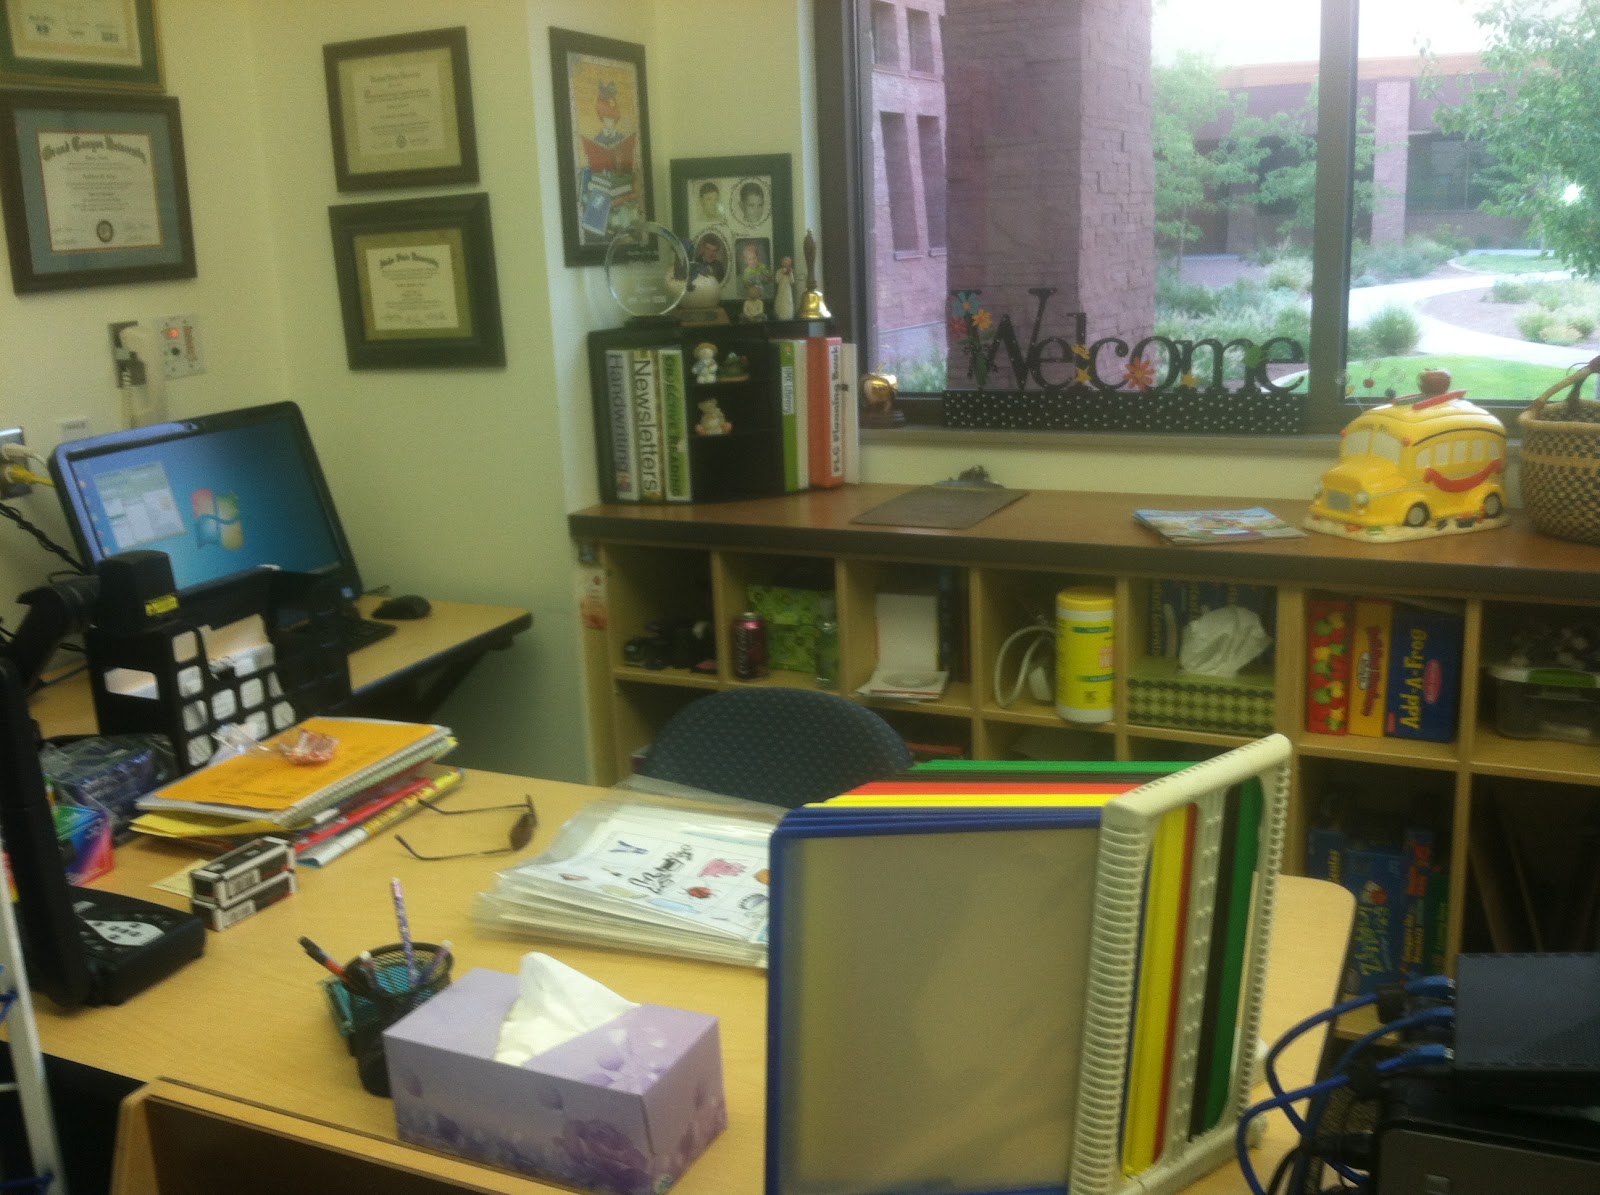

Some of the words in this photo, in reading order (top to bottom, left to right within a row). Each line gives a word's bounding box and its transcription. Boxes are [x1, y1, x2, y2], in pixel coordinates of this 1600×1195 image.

[951, 288, 1305, 394] Welcome
[609, 354, 629, 473] Handwriting
[633, 359, 659, 492] Newsletters
[1400, 628, 1430, 729] Add-A-Frog
